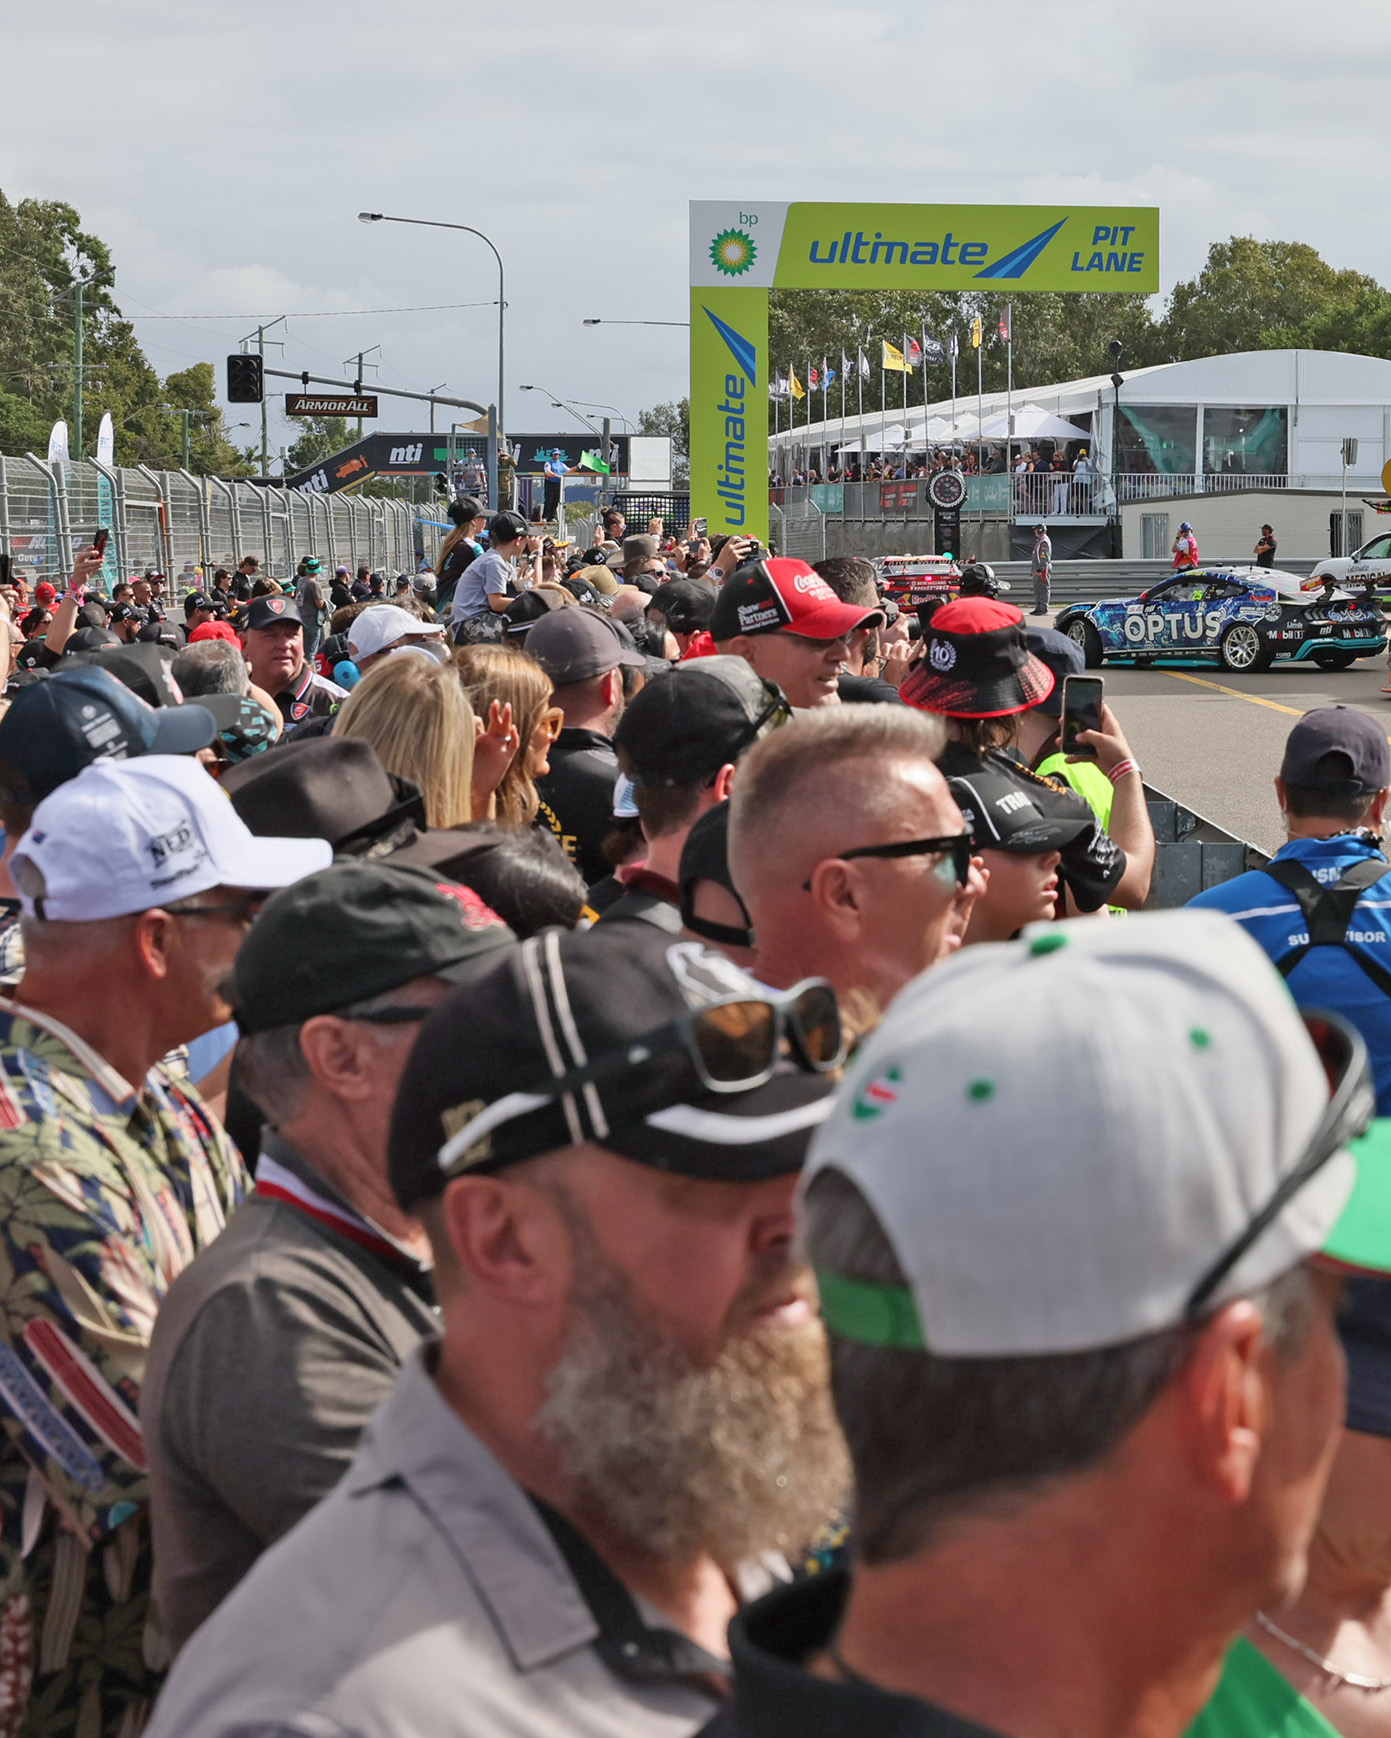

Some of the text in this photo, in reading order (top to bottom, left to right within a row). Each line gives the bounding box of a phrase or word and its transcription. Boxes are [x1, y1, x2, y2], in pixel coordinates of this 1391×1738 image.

[738, 212, 758, 227] bp
[1092, 226, 1135, 246] PIT
[808, 231, 989, 265] ultimate
[1071, 251, 1144, 272] LANE
[294, 396, 370, 413] ARMORALL
[389, 443, 424, 462] nti
[717, 374, 746, 527] ultimate
[1193, 590, 1203, 600] 25
[737, 603, 760, 614] Shaw
[738, 608, 779, 626] Partners
[1124, 611, 1223, 643] OPTUS
[1269, 631, 1294, 640] Mobil
[1320, 626, 1333, 635] nti
[1288, 931, 1386, 946] SUISOR
